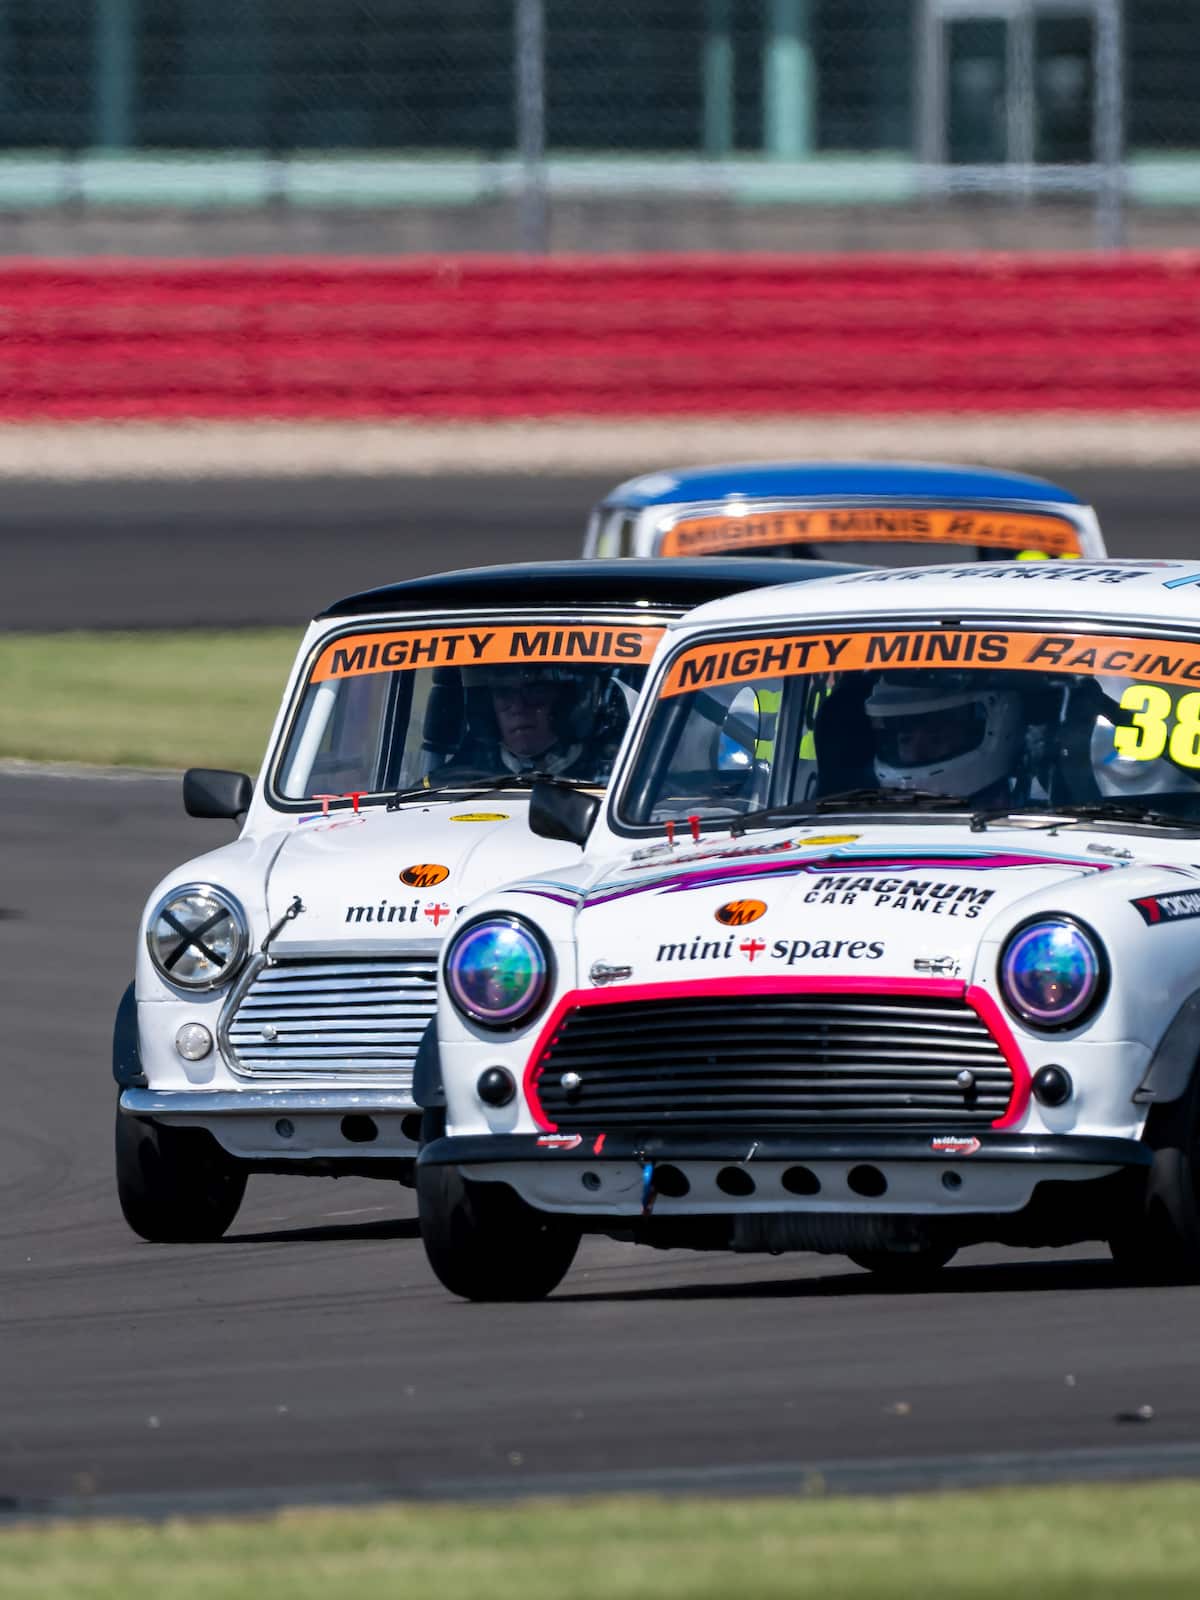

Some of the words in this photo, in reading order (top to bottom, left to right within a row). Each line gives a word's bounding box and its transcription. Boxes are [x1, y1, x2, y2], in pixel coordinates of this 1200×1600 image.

[678, 512, 811, 544] MIGHTY
[829, 511, 930, 532] MINIS
[330, 633, 497, 675] MIGHTY
[509, 631, 643, 658] MINIS
[677, 637, 852, 688] MIGHTY
[864, 633, 1009, 664] MINIS
[803, 890, 858, 906] CAR
[875, 894, 984, 919] PANELS
[812, 875, 996, 905] MAGNUM
[345, 899, 421, 923] mini
[655, 934, 736, 962] mini
[770, 937, 885, 965] spares
